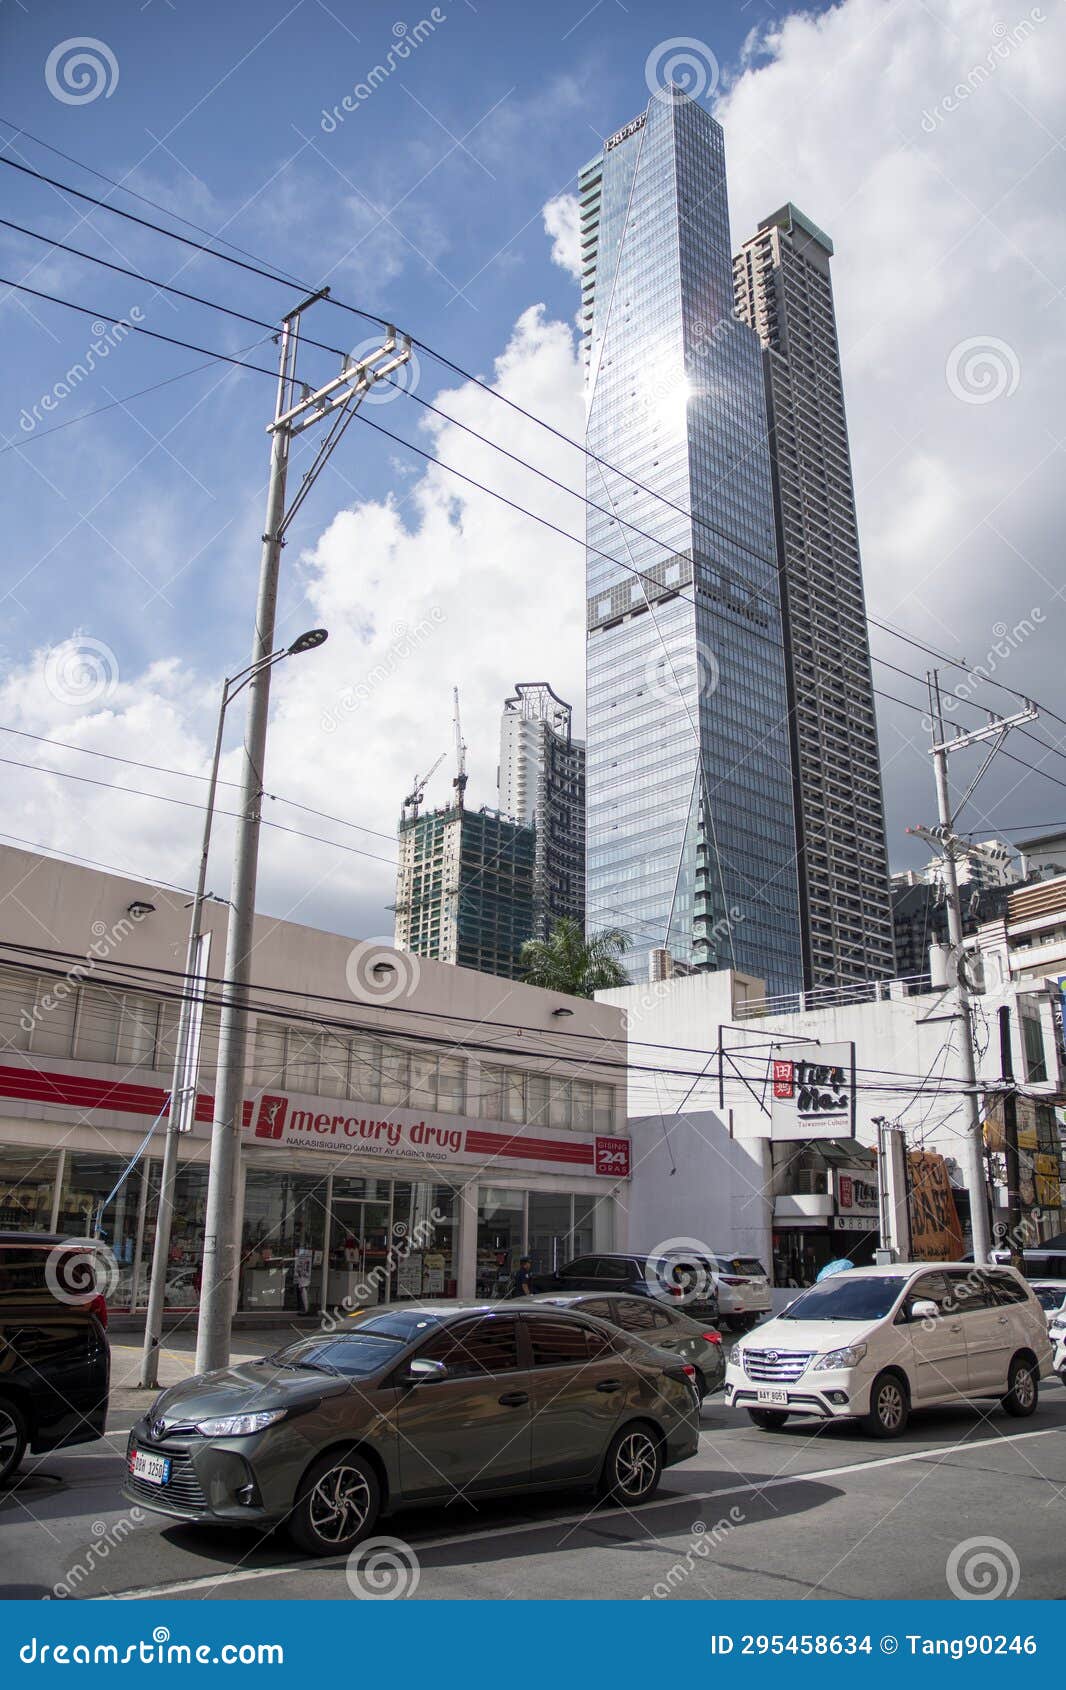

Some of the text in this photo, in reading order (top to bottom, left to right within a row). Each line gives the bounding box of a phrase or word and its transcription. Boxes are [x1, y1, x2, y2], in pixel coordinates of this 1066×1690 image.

[289, 1110, 462, 1153] mercury drug
[353, 1144, 383, 1153] GAMOT
[598, 1150, 627, 1165] 24
[599, 1165, 627, 1173] ORAS
